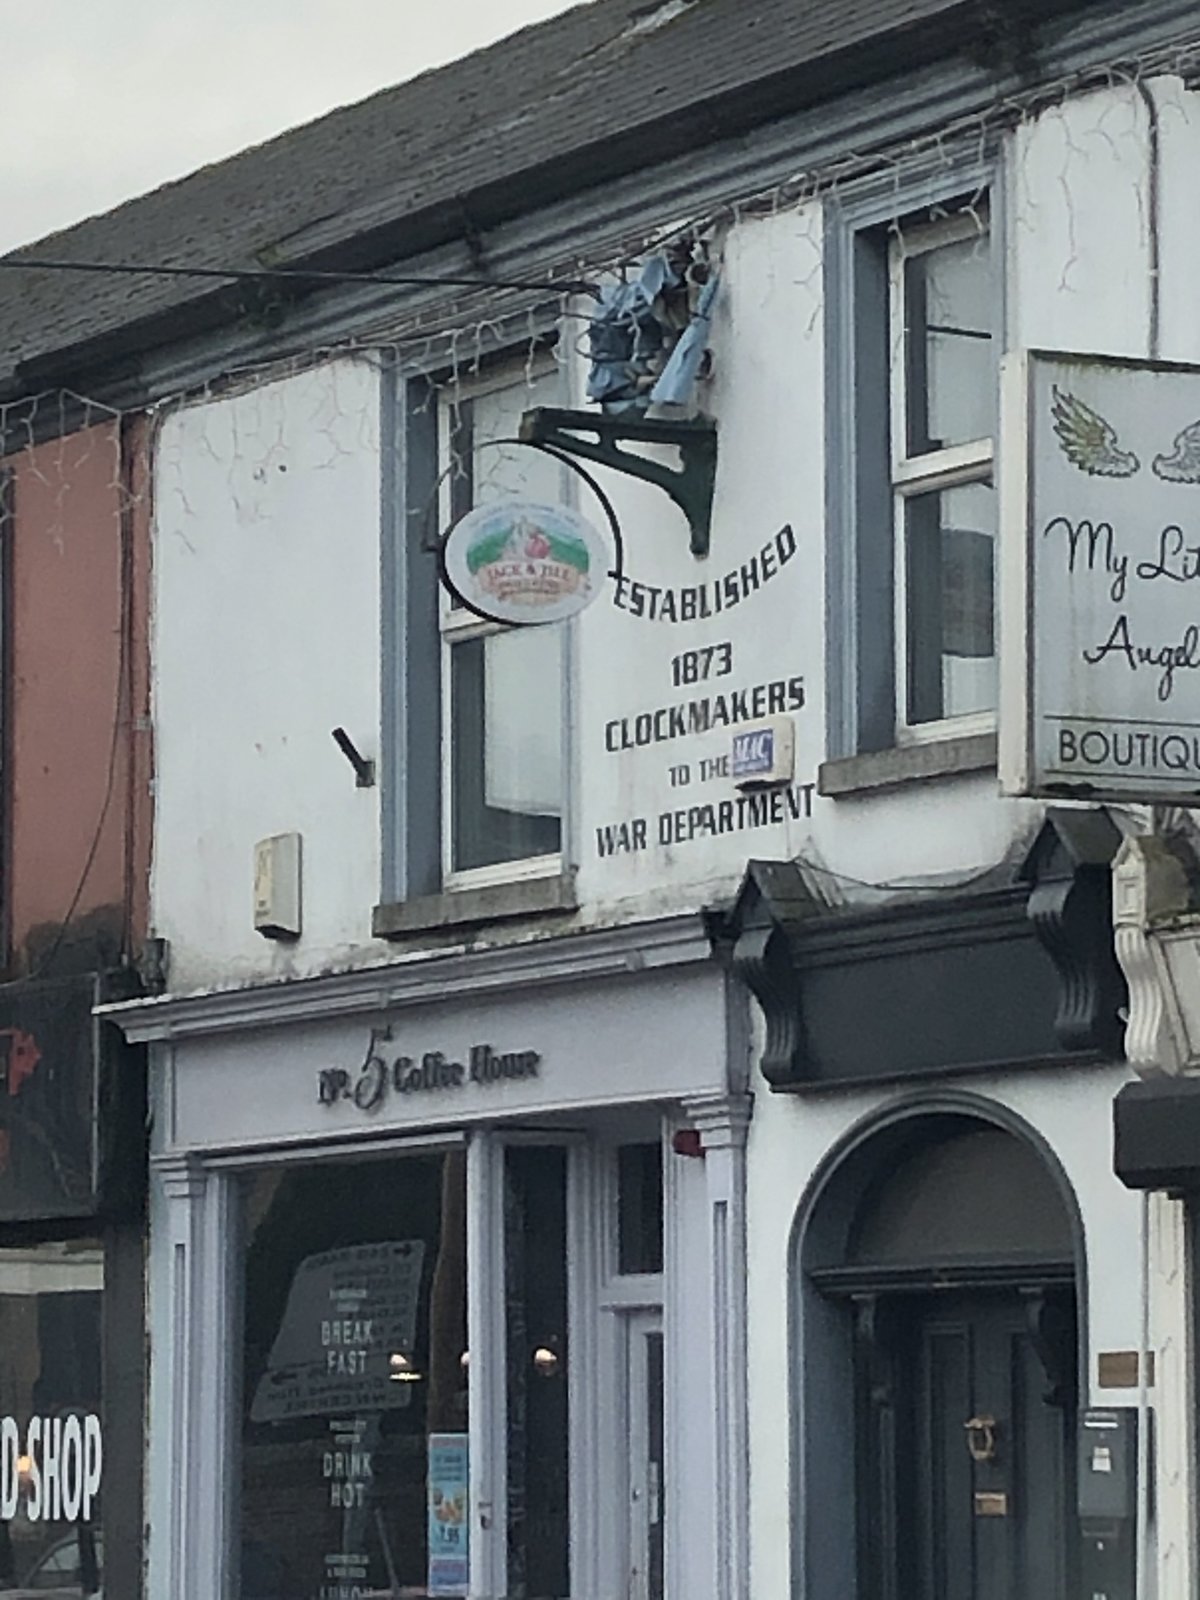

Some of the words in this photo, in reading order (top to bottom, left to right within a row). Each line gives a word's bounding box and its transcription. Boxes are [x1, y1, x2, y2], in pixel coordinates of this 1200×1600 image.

[613, 524, 797, 623] ESTABLISHED
[1044, 517, 1128, 602] My
[671, 642, 733, 687] 1873
[605, 676, 805, 752] CLOCKMAKERS
[1059, 729, 1200, 770] BOUTIQ
[668, 764, 690, 788] TO
[699, 755, 729, 783] THE
[596, 818, 647, 858] WAR
[658, 784, 816, 846] DEPARTMENT
[321, 1320, 373, 1346] BREAK
[327, 1351, 367, 1375] FAST
[27, 1414, 102, 1521] SHOP
[323, 1452, 372, 1477] DRINK
[331, 1483, 365, 1508] HOT
